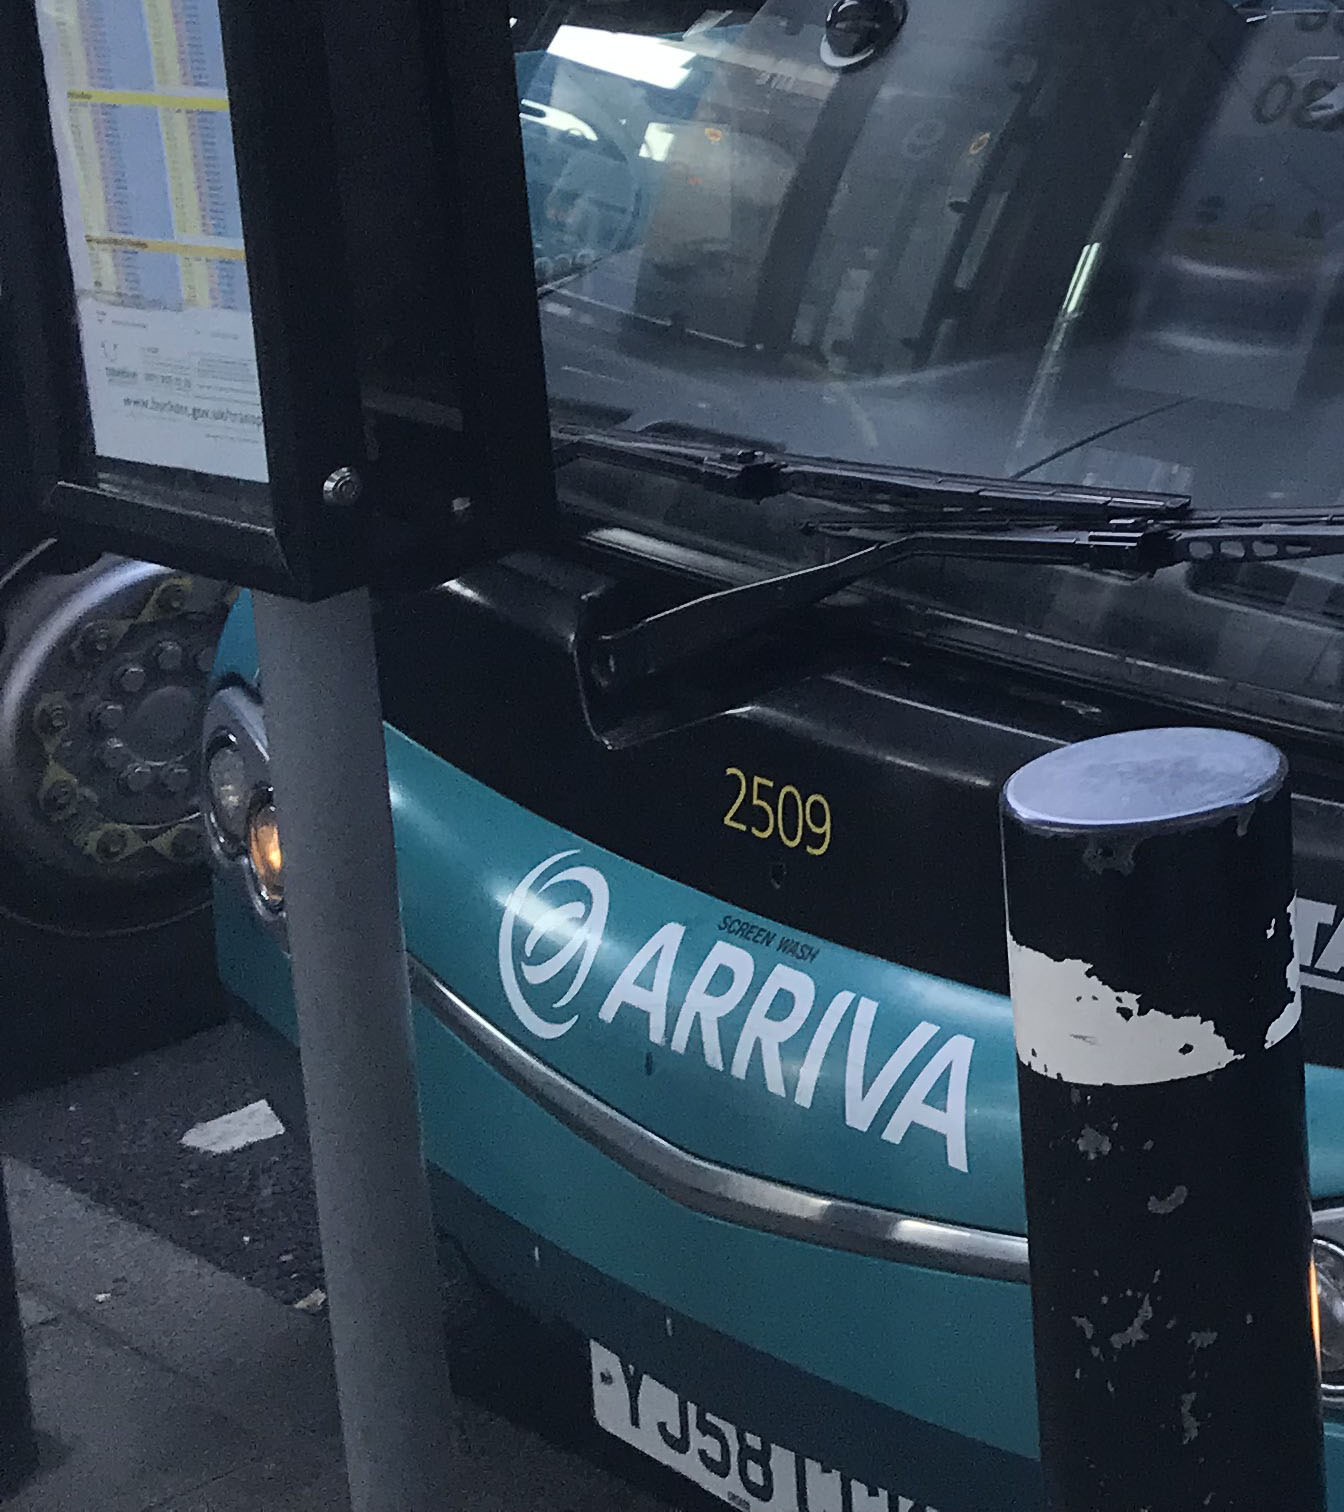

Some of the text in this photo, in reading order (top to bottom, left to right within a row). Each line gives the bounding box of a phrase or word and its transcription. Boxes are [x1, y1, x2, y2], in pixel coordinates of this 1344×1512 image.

[722, 767, 832, 856] 2509
[717, 915, 820, 964] SCREEN WASH
[598, 921, 976, 1173] ARRIVA
